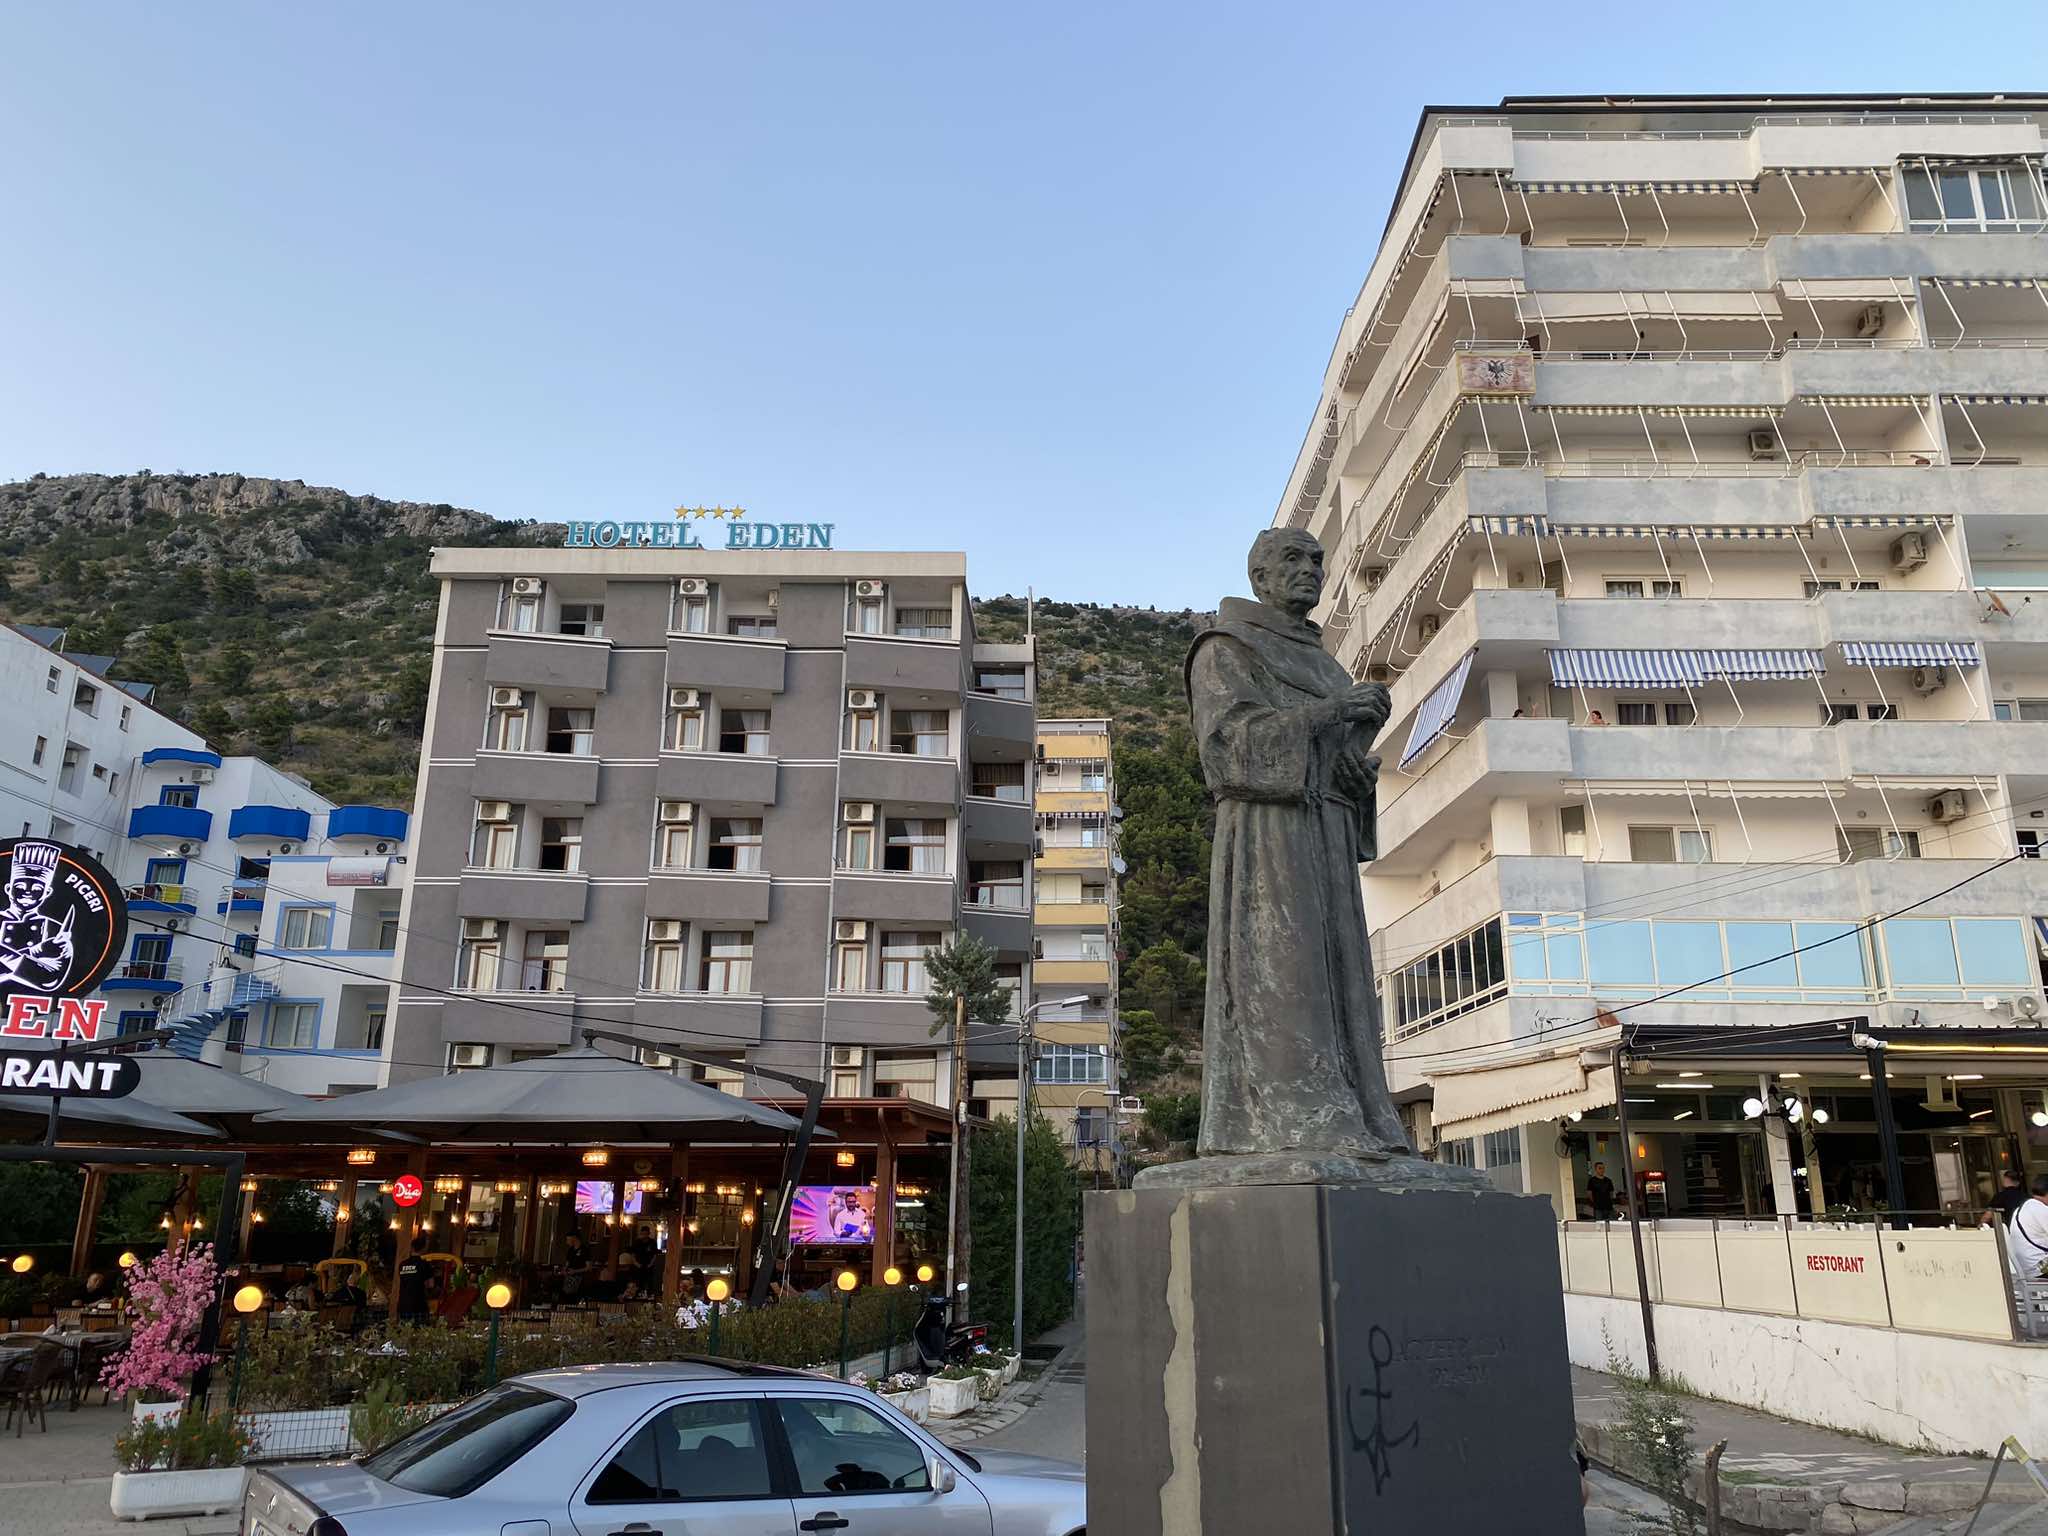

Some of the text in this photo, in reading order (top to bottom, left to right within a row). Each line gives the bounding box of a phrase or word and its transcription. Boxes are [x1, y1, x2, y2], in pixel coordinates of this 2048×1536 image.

[564, 520, 834, 550] HOTEL EDEN
[64, 873, 104, 913] PICERI
[0, 1057, 121, 1091] RANT
[1806, 1255, 1864, 1274] RESTORANT
